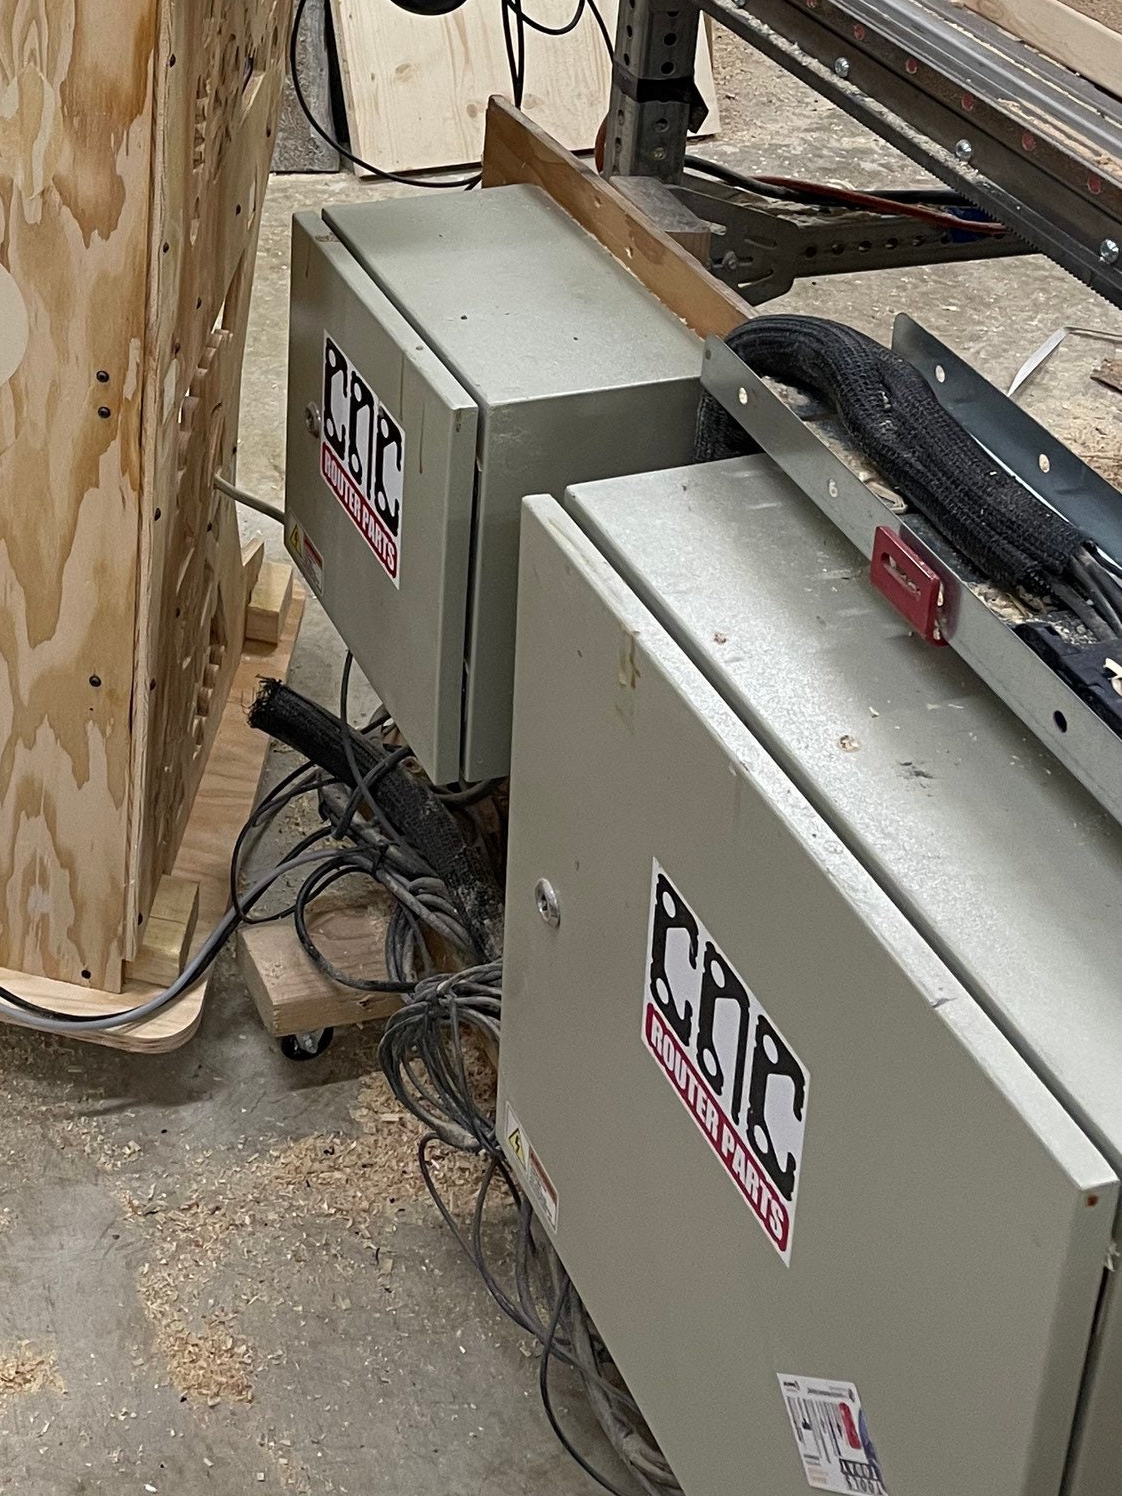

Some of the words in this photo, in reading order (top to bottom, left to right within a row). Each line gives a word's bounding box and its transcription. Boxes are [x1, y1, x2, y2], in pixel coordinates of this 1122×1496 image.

[324, 449, 361, 522] ROUTER
[362, 504, 396, 571] PARTS
[651, 1013, 719, 1141] ROUTER
[721, 1133, 784, 1242] PARTS
